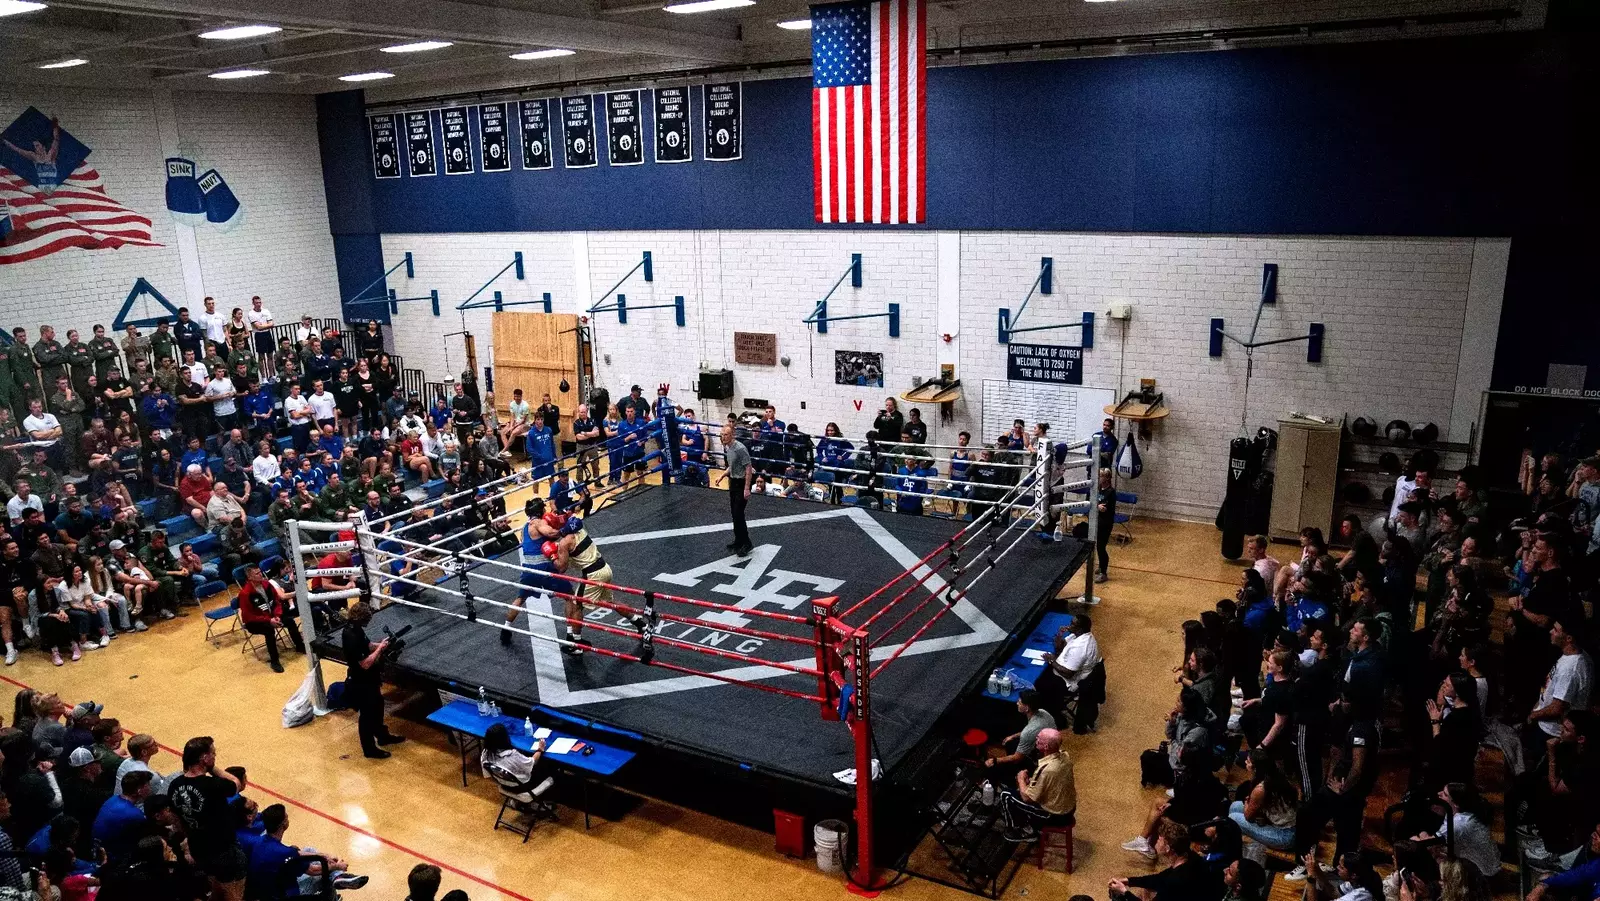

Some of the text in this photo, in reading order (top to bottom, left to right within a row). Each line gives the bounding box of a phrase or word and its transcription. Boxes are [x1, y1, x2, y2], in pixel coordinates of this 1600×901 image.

[171, 164, 191, 174] SINK
[200, 174, 218, 191] NAVY
[1009, 345, 1081, 359] CAUTION: LACK OF OXYGEN
[1015, 357, 1073, 370] WELCOME TO 7250 FT
[1033, 369, 1042, 379] AIR
[1044, 370, 1050, 379] IS
[1514, 385, 1527, 393] DO
[1530, 386, 1548, 394] NOT
[1551, 387, 1580, 396] BLOCK
[903, 478, 915, 492] AF
[652, 543, 846, 628] AF
[855, 638, 863, 717] RINGSIDE
